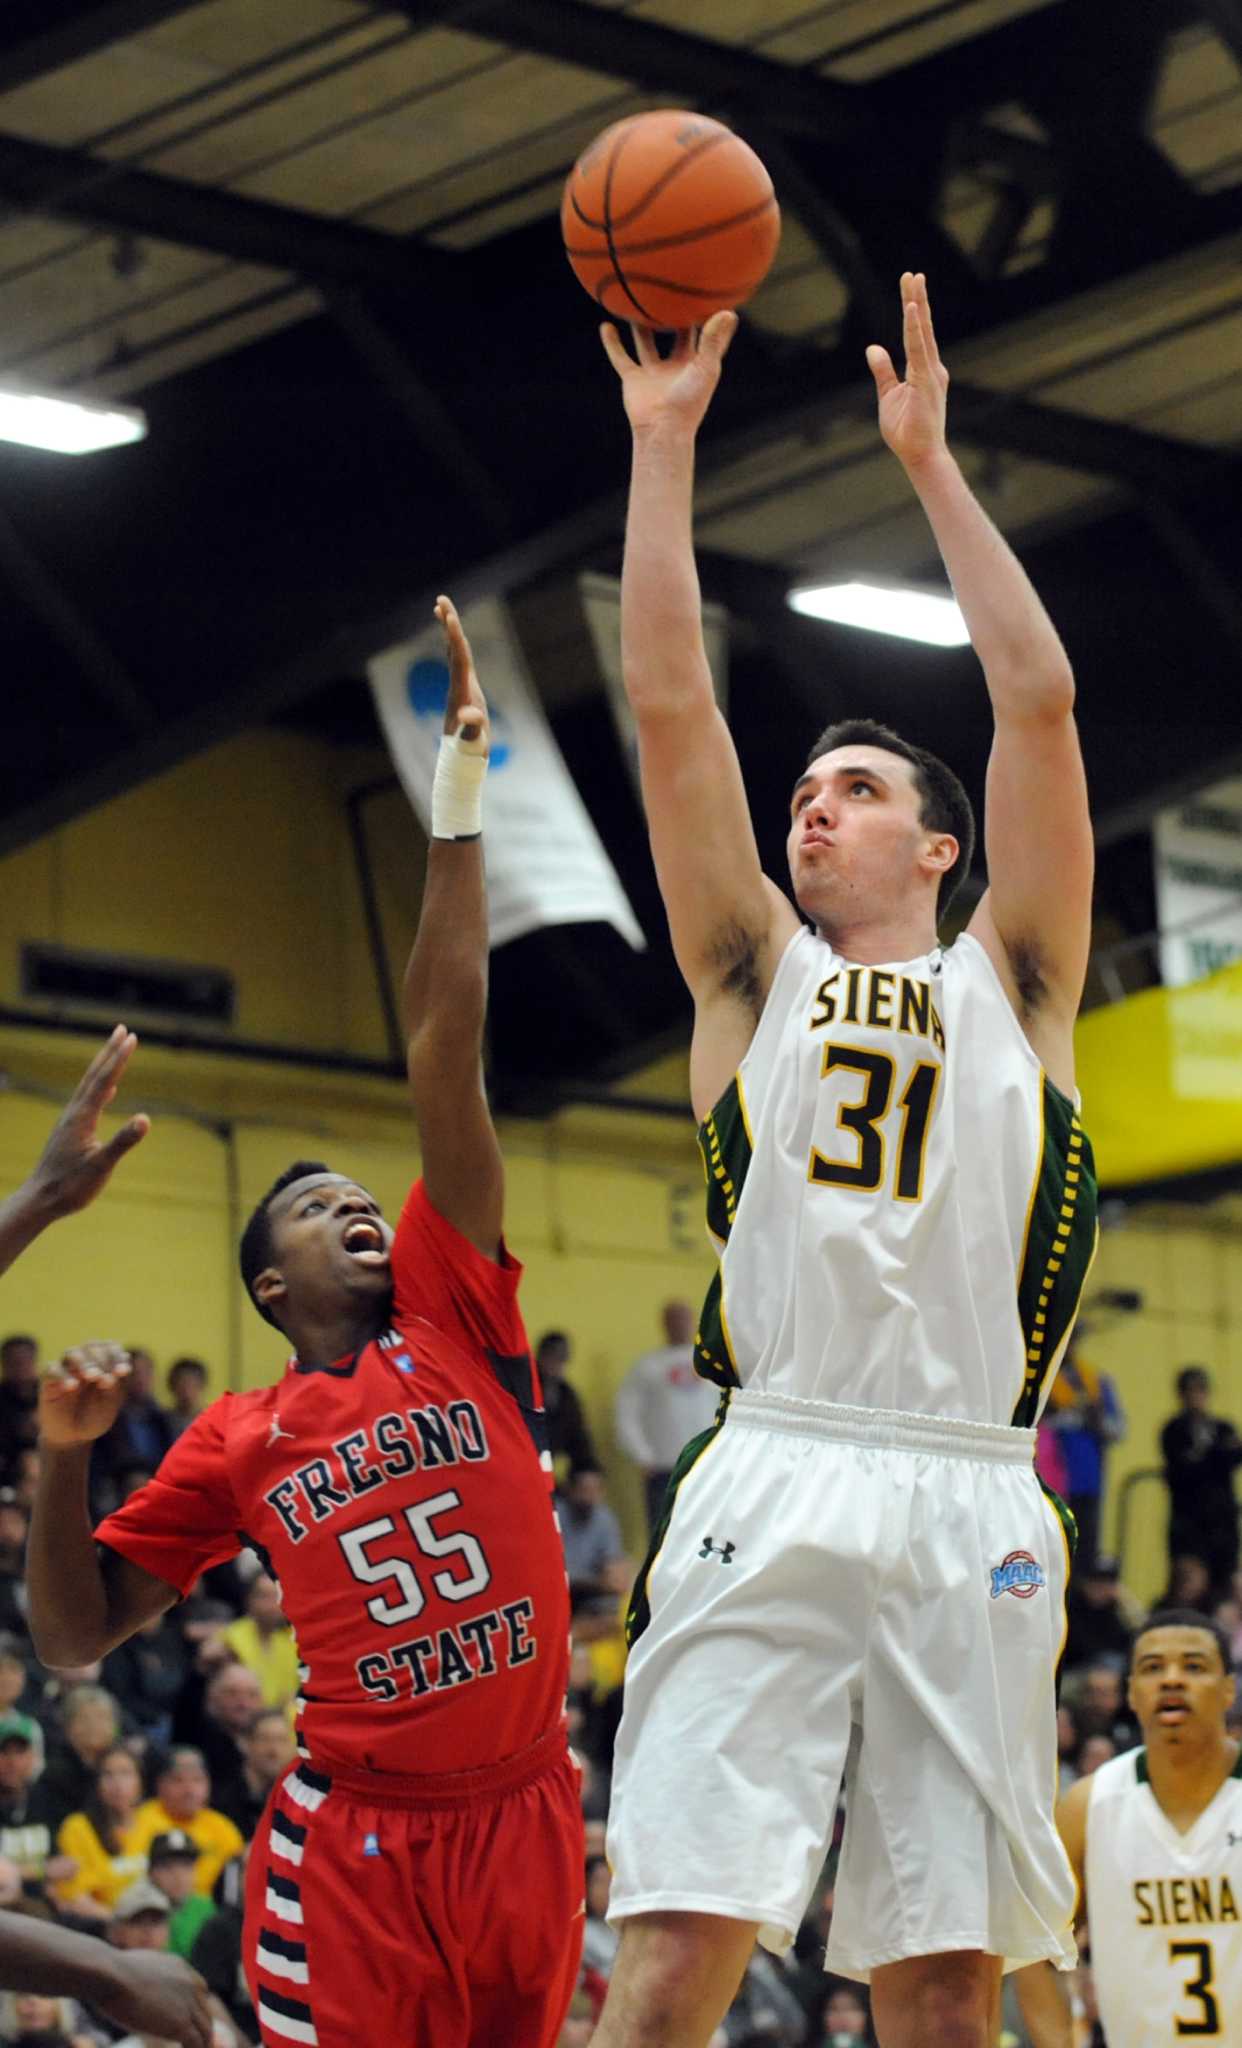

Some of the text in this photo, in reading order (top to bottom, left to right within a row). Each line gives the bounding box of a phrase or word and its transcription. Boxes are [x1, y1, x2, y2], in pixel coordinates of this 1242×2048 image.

[808, 1041, 942, 1204] 31
[264, 1399, 490, 1543] FRESNO
[337, 1488, 492, 1628] 55
[991, 1562, 1046, 1599] MAAC
[355, 1597, 537, 1701] STATE
[1133, 1874, 1241, 1926] SIENA
[1168, 1939, 1222, 2038] 3
